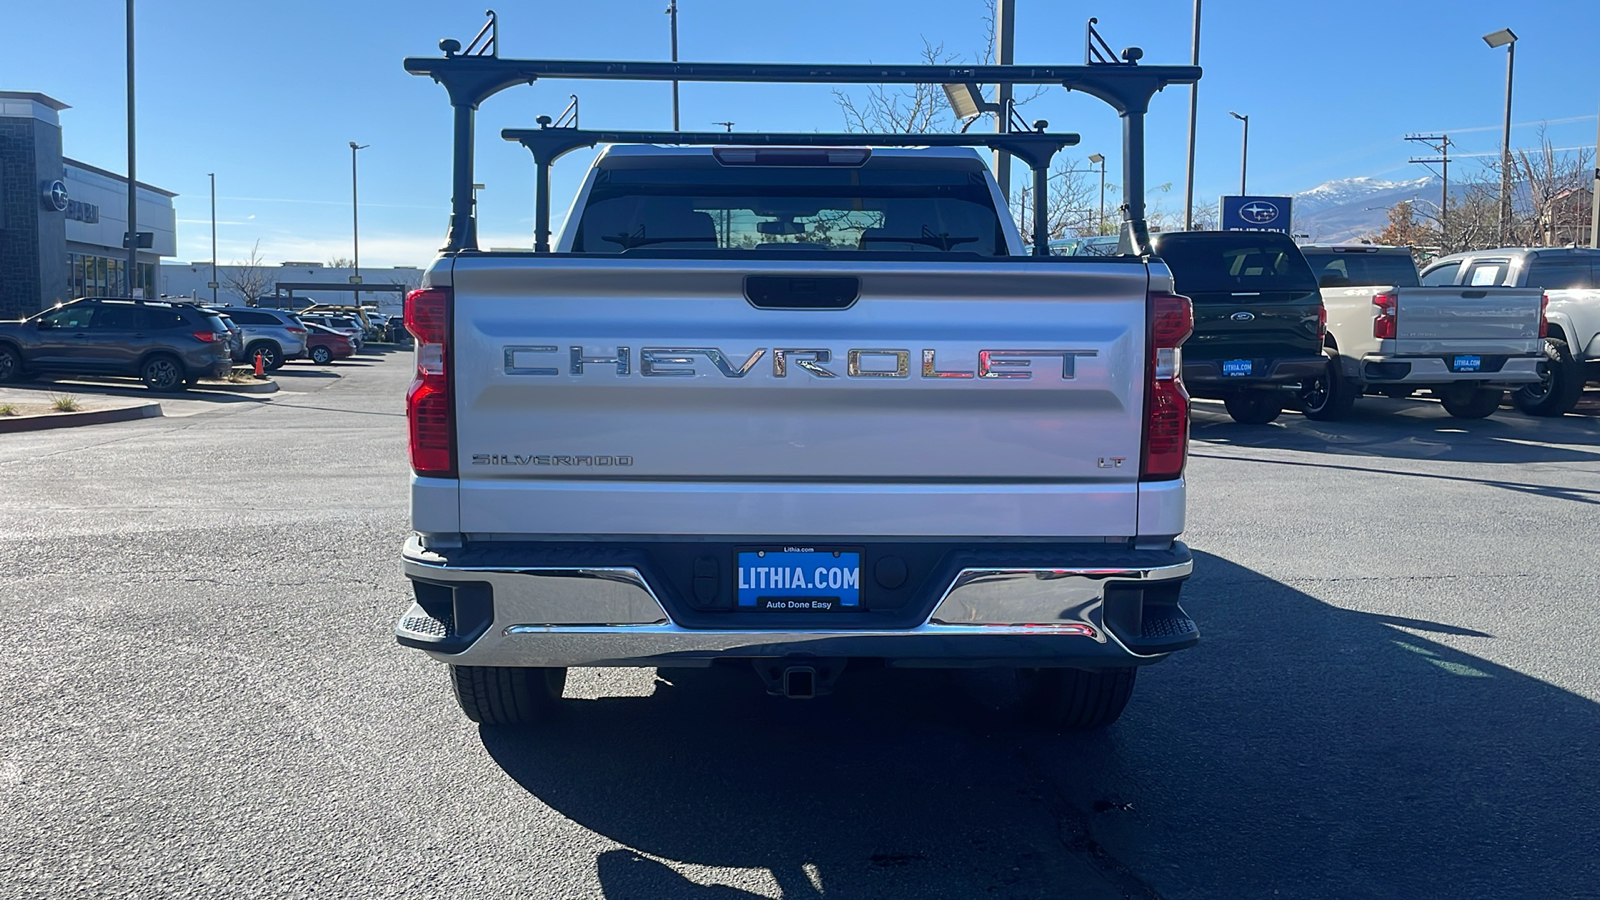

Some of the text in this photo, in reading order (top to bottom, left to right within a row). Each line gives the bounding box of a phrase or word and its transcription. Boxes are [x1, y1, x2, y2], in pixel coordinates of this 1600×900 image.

[502, 345, 1099, 380] CHEVROLET
[472, 454, 634, 466] SILVERADO
[1098, 457, 1126, 468] LT
[738, 567, 859, 589] LITHIA.COM
[766, 601, 832, 610] Auto Done Easy
